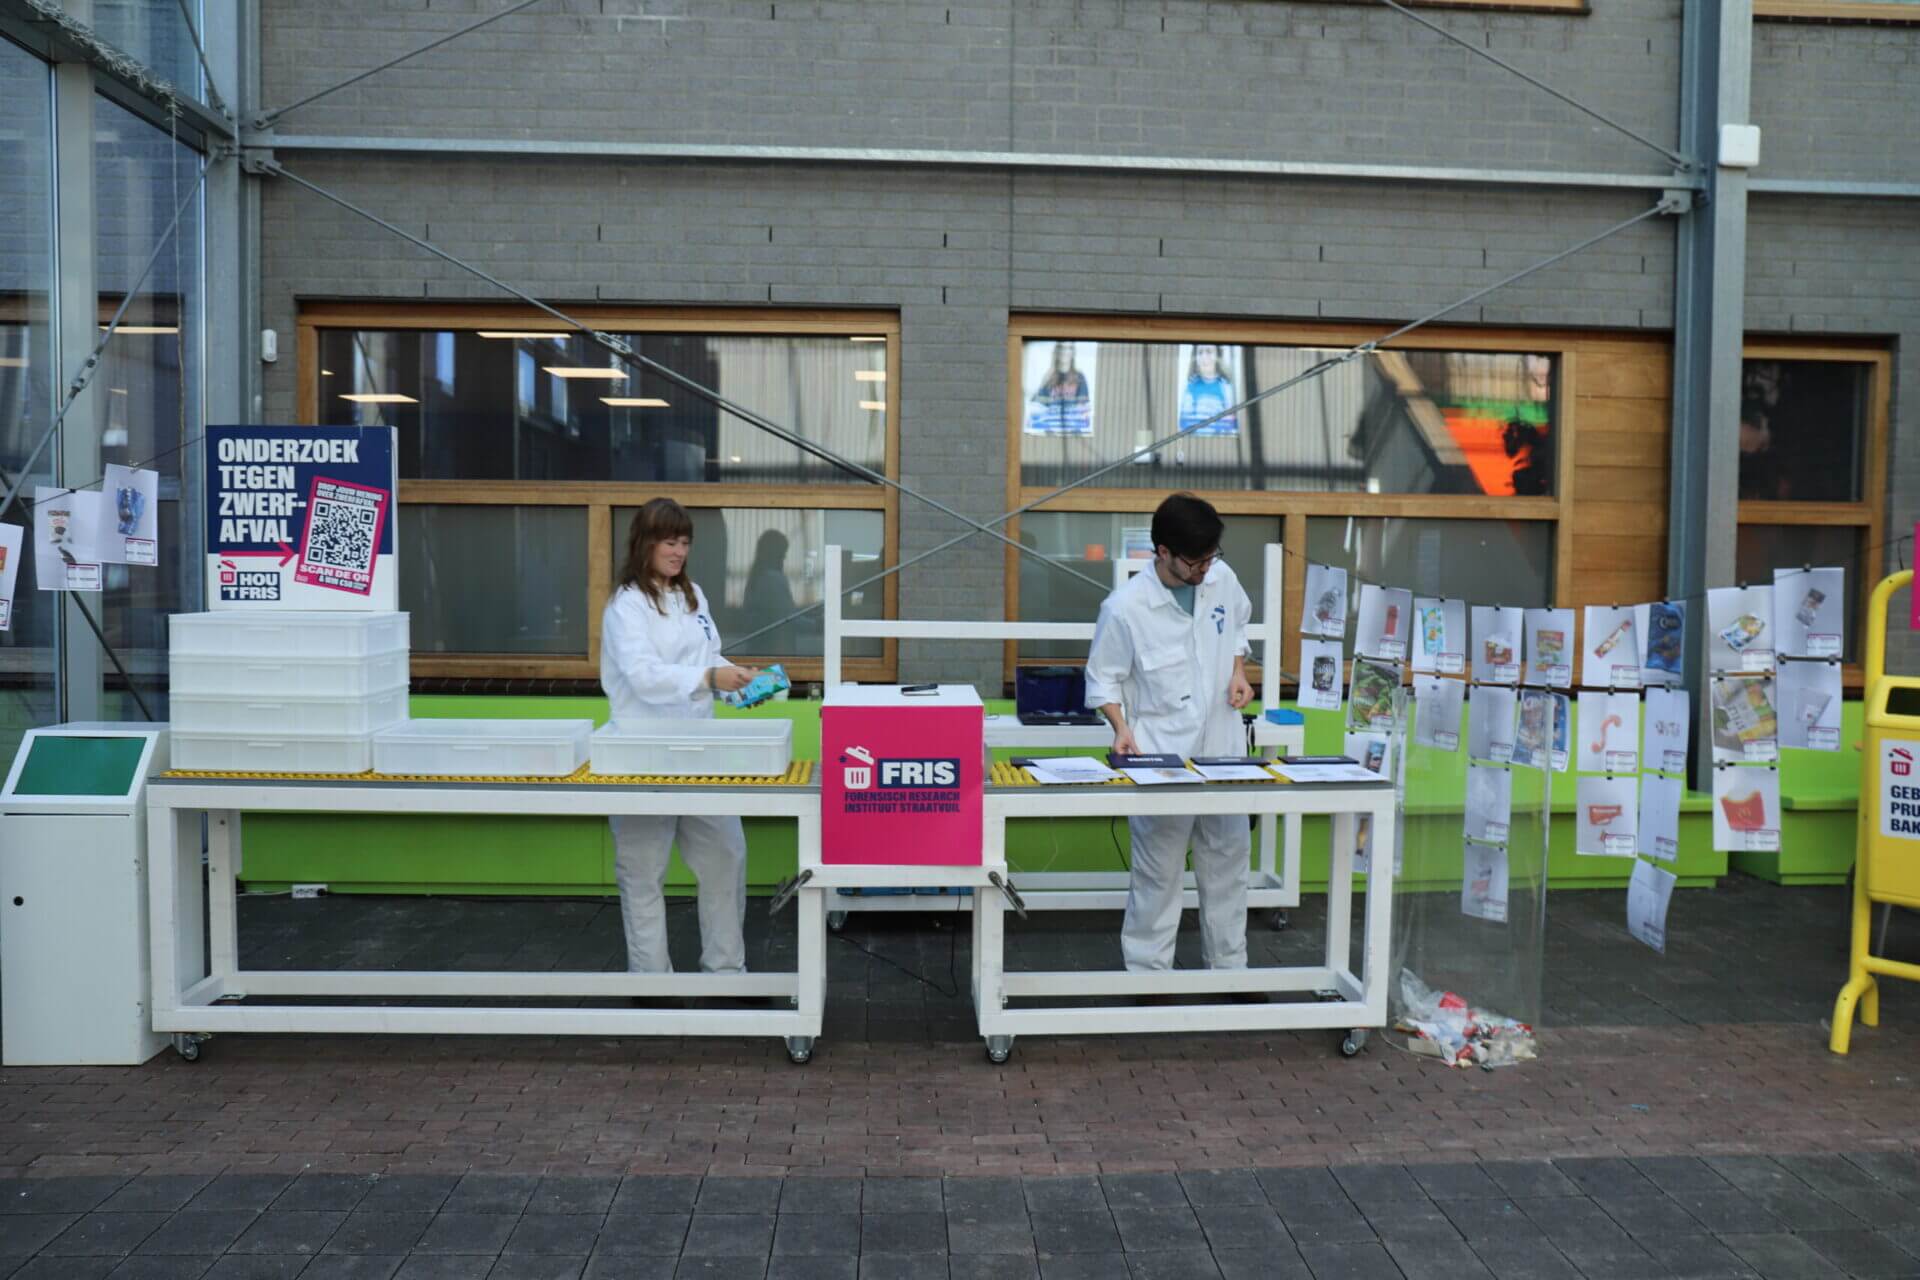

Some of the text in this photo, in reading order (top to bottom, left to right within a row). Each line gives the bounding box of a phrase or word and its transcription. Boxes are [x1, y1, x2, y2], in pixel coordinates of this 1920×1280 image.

[218, 438, 360, 463] ONDERZOEK
[218, 466, 296, 490] TEGEN
[219, 492, 307, 516] ZWERF-
[219, 519, 293, 543] AFVAL
[239, 573, 278, 586] HOU
[299, 564, 333, 577] SCAN
[334, 570, 351, 580] DE
[240, 586, 279, 600] FRIS
[882, 761, 956, 785] FRIS
[845, 791, 960, 801] FORENSISCH RESEARCH
[1890, 785, 1920, 800] GEB
[845, 803, 960, 813] INSTITUUT STRAATVUIL
